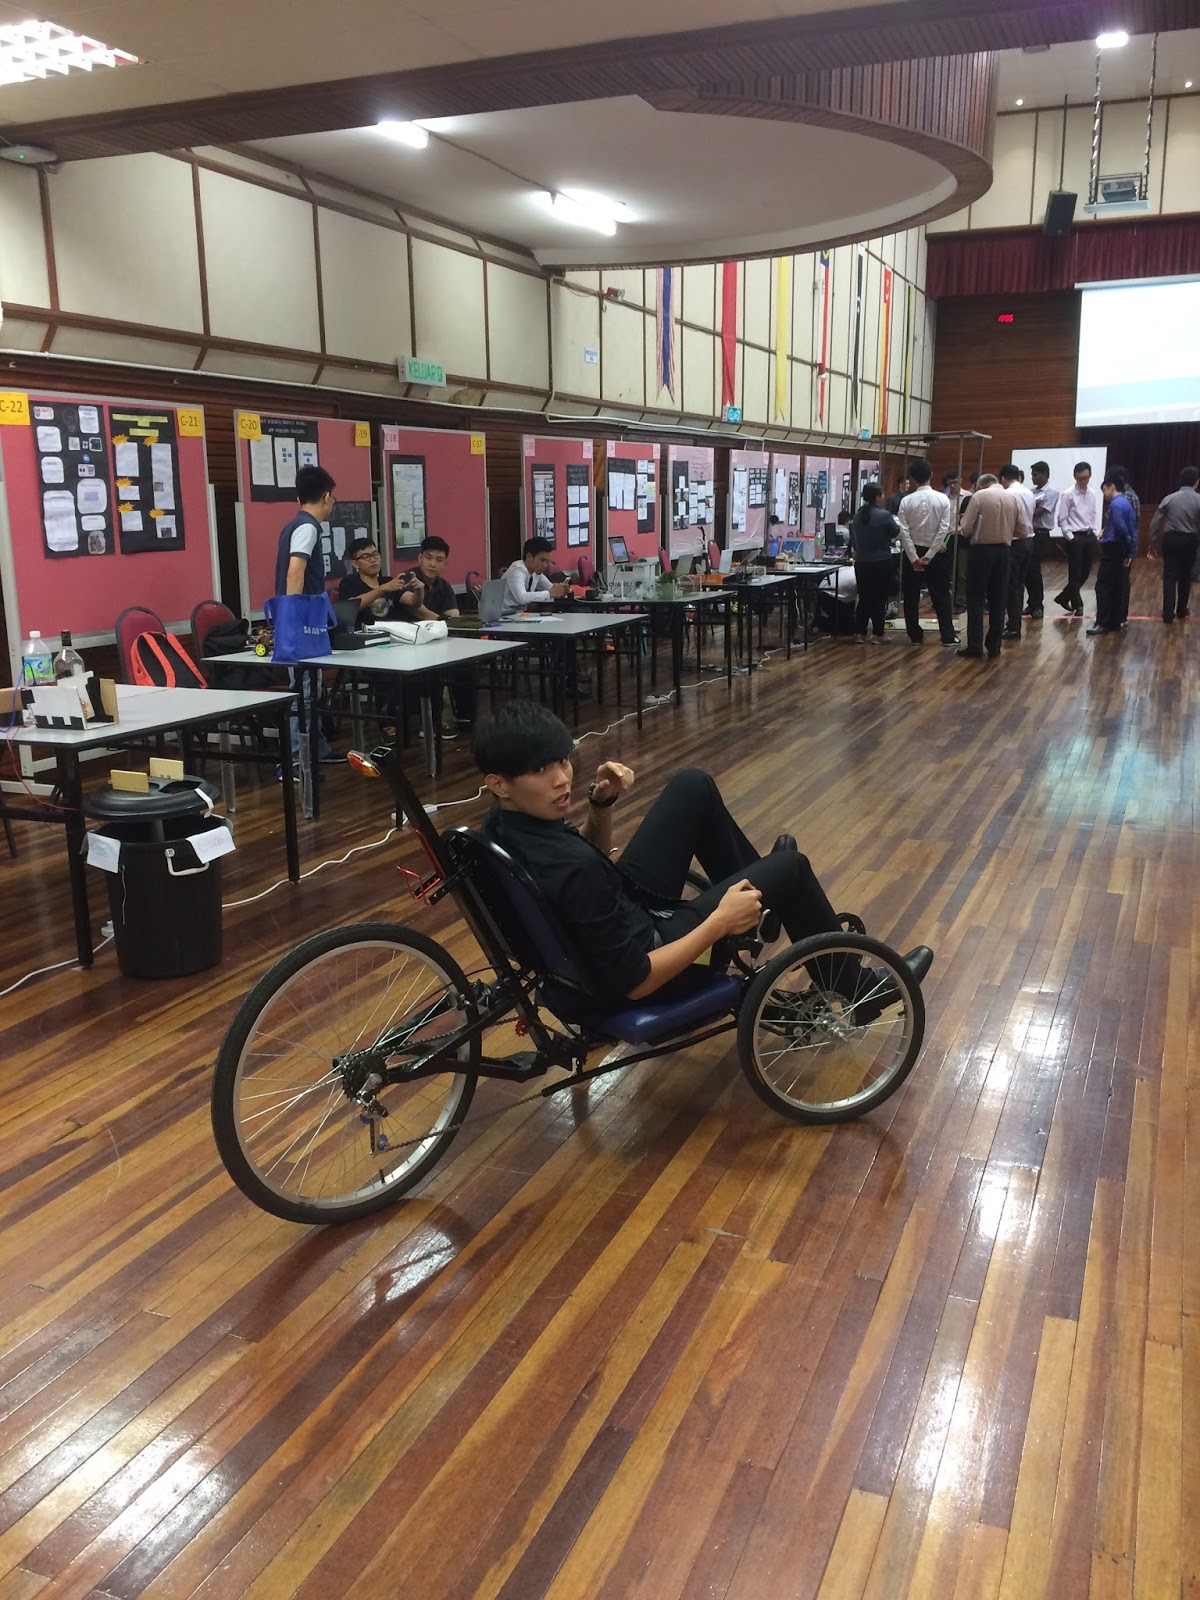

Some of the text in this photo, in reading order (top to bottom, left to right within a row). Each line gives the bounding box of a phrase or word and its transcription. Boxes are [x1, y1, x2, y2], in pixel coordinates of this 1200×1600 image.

[408, 361, 436, 381] KELUAR
[0, 400, 23, 413] C-22
[180, 415, 199, 427] C-21
[240, 418, 258, 431] C-20
[386, 433, 397, 443] C-18
[472, 439, 483, 448] C-17
